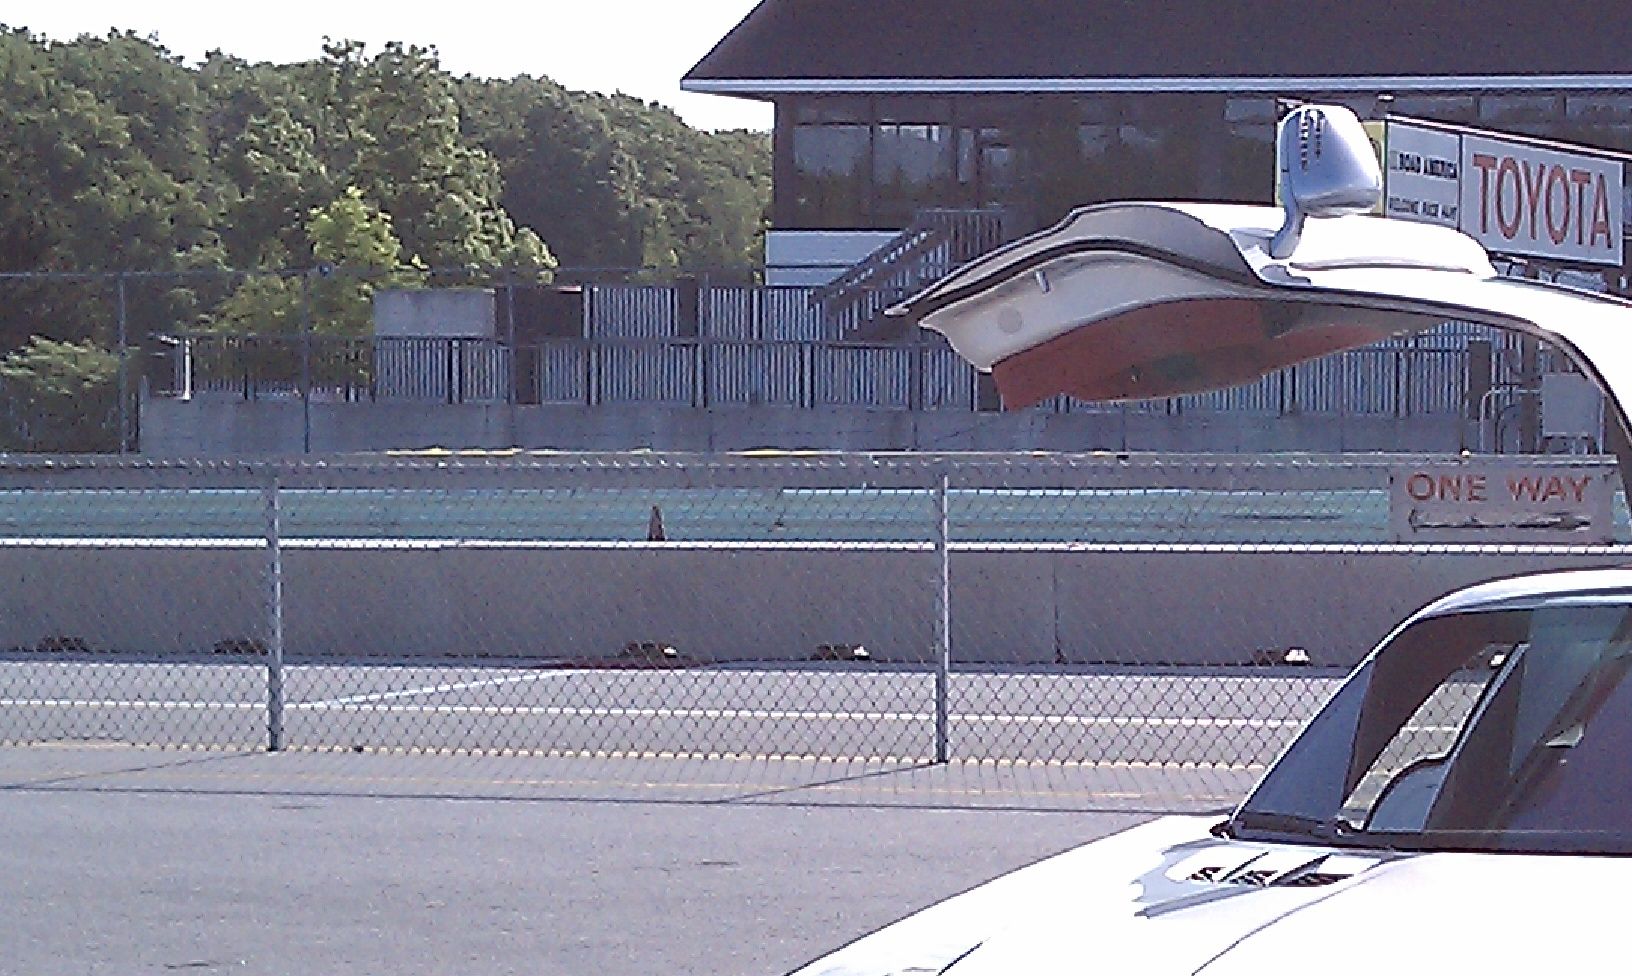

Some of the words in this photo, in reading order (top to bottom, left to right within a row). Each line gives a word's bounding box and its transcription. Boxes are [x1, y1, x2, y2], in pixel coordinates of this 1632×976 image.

[1472, 151, 1613, 250] TOYOTA
[1407, 472, 1488, 502] ONE
[1505, 474, 1593, 503] WAY
